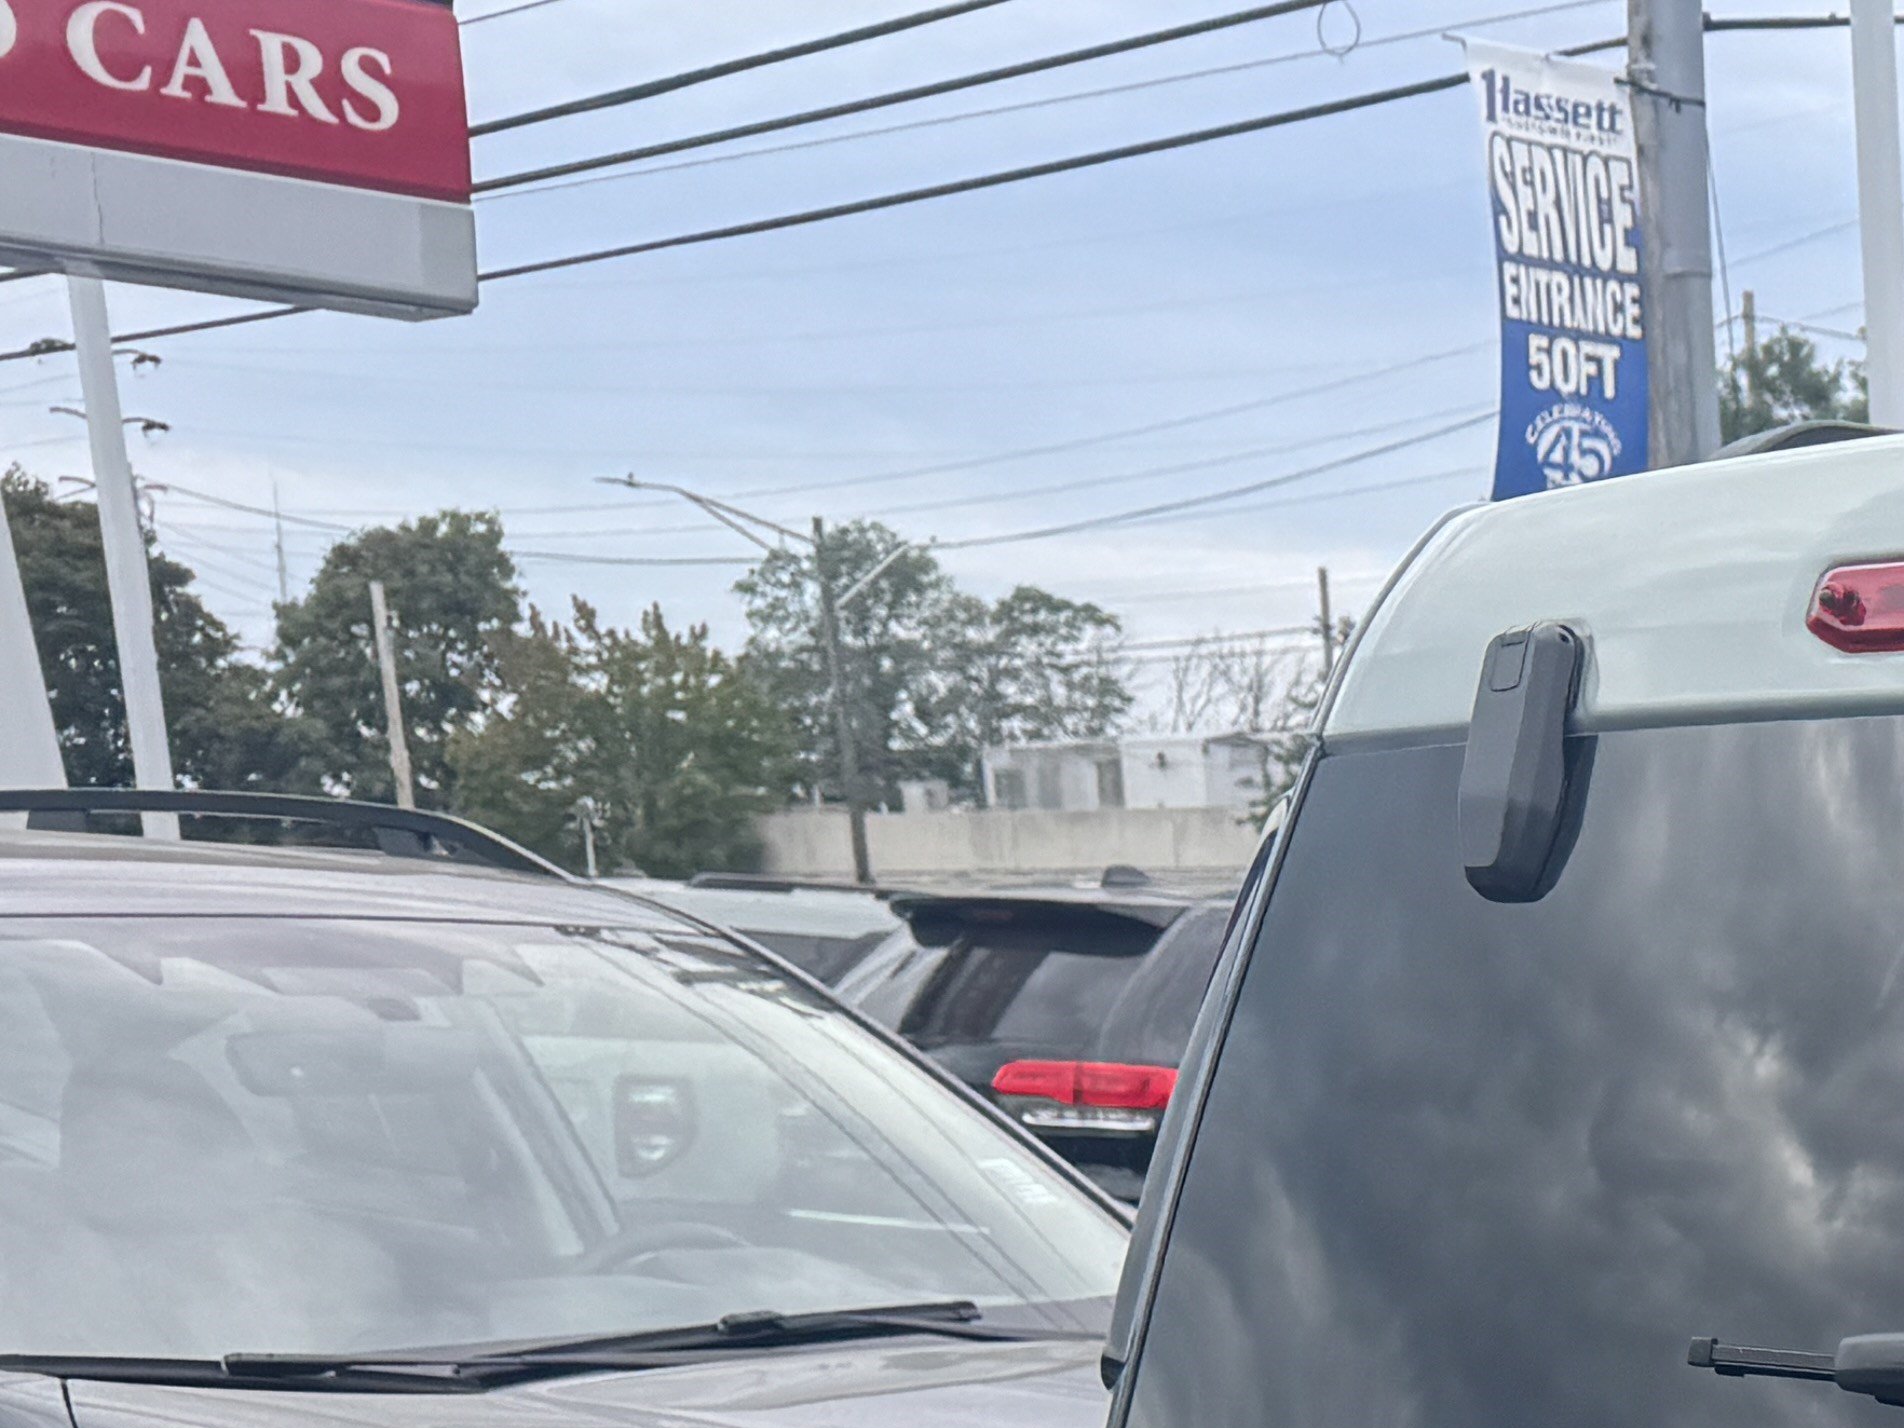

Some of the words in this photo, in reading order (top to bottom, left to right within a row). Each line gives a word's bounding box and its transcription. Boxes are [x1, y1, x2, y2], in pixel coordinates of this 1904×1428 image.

[66, 1, 400, 131] CARS
[1481, 69, 1624, 135] Hassett
[1491, 133, 1639, 275] SERVICE
[1502, 260, 1644, 340] ENTRANCE
[1528, 332, 1622, 400] 50FT
